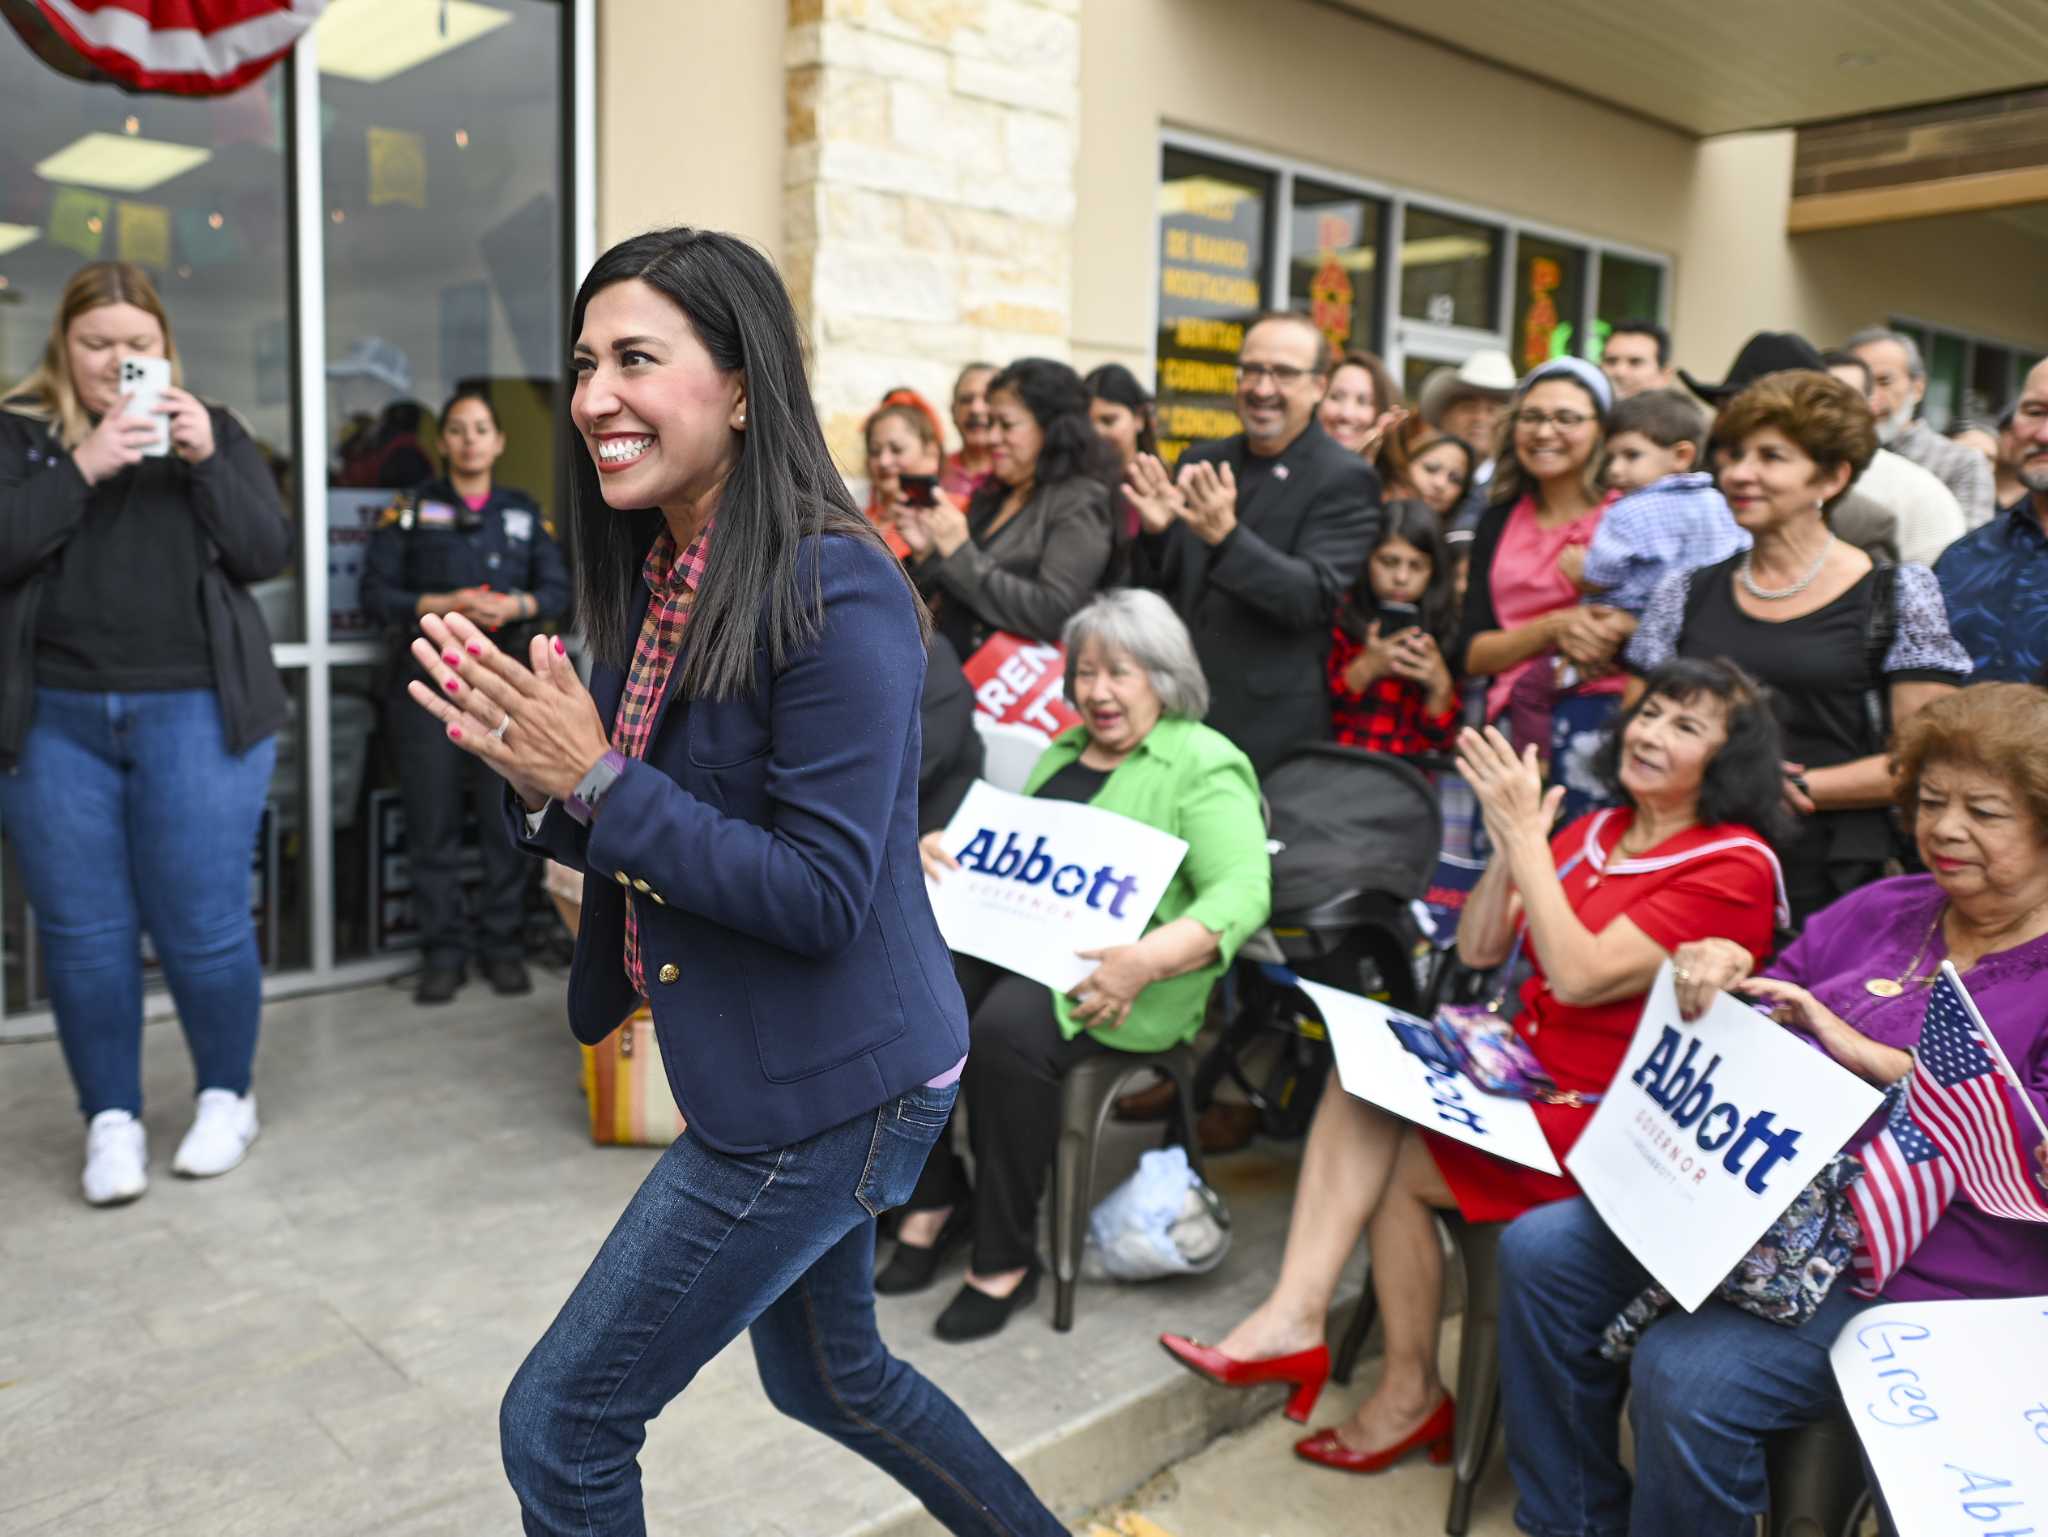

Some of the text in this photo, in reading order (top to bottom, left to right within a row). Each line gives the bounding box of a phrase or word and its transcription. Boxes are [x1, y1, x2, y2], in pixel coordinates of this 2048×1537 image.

[955, 827, 1139, 920] Abbott
[1631, 1024, 1803, 1196] Abbott
[1634, 1108, 1707, 1185] GOVERNOR
[1856, 1320, 1939, 1428] Greg
